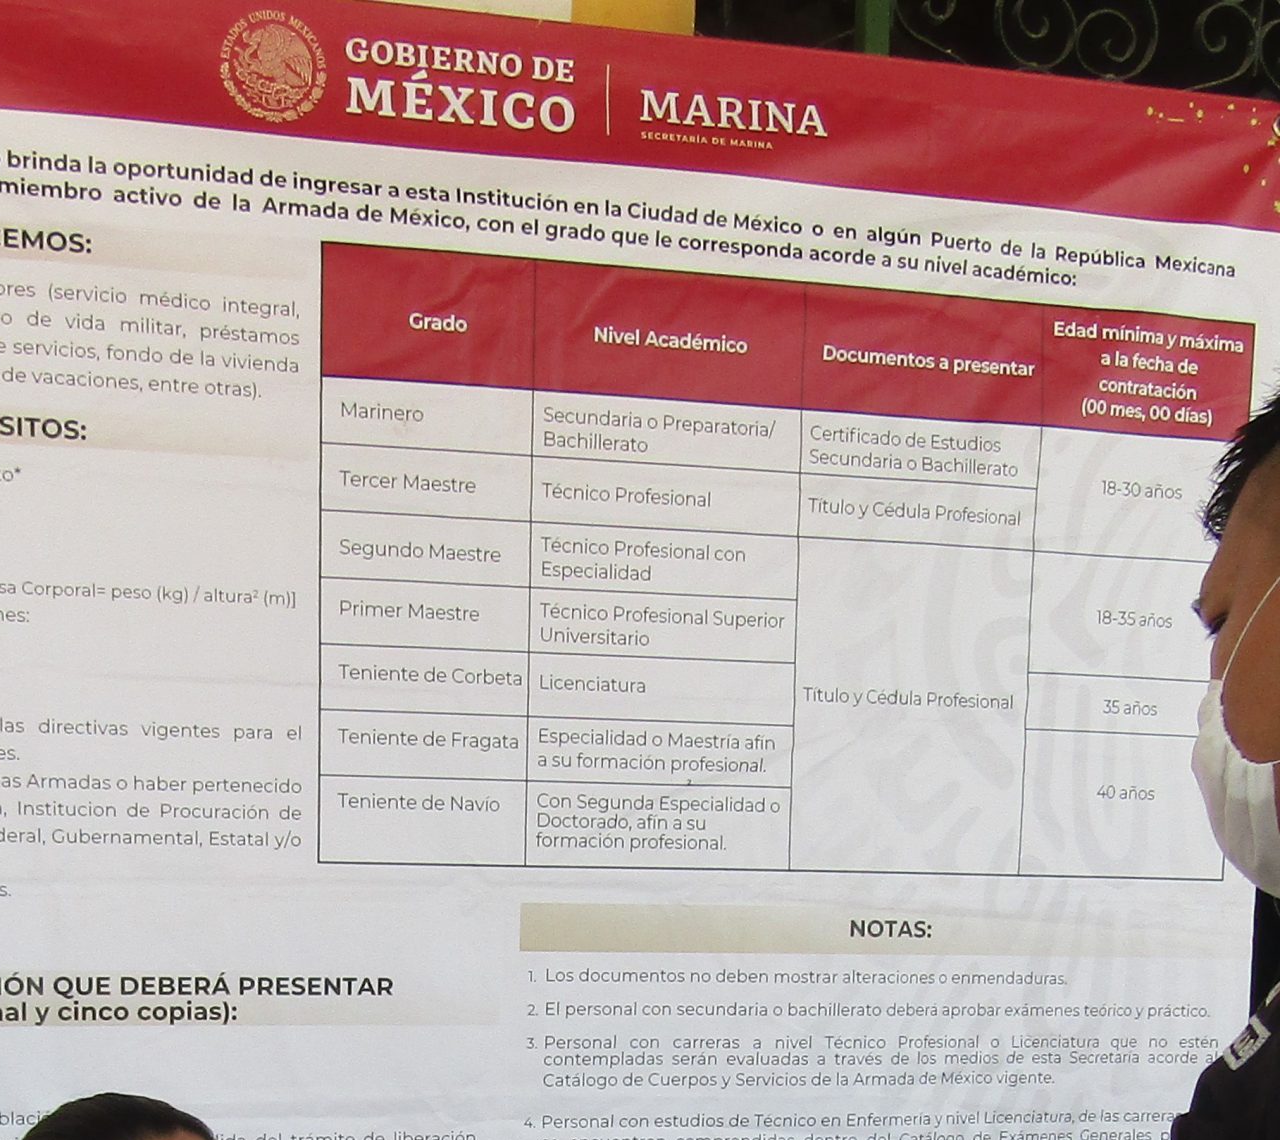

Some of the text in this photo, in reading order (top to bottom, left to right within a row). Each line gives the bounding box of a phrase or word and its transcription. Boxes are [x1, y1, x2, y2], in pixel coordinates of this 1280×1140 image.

[221, 10, 326, 69] ESTADOS UNIDOS MEXICANOS
[345, 37, 574, 83] GOBIERNO DE
[345, 69, 575, 133] MÉXICO
[640, 89, 828, 137] MARINA
[641, 131, 773, 150] SECRETARÍA DE MARINA
[7, 149, 81, 173] brinda
[88, 156, 106, 174] la
[113, 162, 253, 185] oportunidad
[259, 169, 287, 188] de
[293, 171, 382, 196] ingresar
[388, 185, 399, 198] a
[405, 186, 450, 202] esta
[456, 187, 568, 213] Institución
[573, 201, 599, 216] en
[605, 199, 622, 217] la
[627, 202, 698, 225] Ciudad
[703, 209, 728, 228] de
[733, 213, 802, 235] México
[812, 224, 824, 236] o
[833, 226, 857, 240] en
[867, 226, 921, 247] algún
[931, 232, 992, 253] Puerto
[1000, 239, 1022, 257] de
[1031, 242, 1046, 259] la
[1055, 246, 1145, 269] República
[1155, 255, 1235, 277] Mexicana
[113, 186, 182, 207] activo
[193, 190, 221, 210] de
[233, 193, 250, 212] la
[262, 196, 349, 220] Armada
[356, 204, 383, 223] de
[390, 207, 470, 233] México,
[477, 217, 514, 234] con
[521, 218, 539, 236] el
[545, 223, 605, 242] grado
[611, 230, 649, 248] que
[655, 229, 672, 248] le
[678, 237, 803, 259] corresponda
[809, 247, 876, 266] acorde
[881, 255, 892, 267] a
[897, 256, 919, 270] su
[924, 255, 968, 275] nivel
[972, 264, 1076, 286] académico:
[409, 312, 467, 332] Grado
[594, 326, 748, 353] Nivel Académico
[1054, 321, 1244, 353] Edad mínima y máxima
[823, 345, 1035, 376] Documentos a presentar
[1101, 350, 1198, 375] a la fecha de
[1099, 379, 1197, 400] contratación
[341, 401, 424, 422] Marinero
[1082, 397, 1212, 427] (00 mes, 00 días)
[339, 470, 476, 494] Tercer Maestre
[1101, 480, 1183, 500] 18-30 años
[541, 482, 711, 507] Técnico Profesional
[339, 539, 501, 563] Segundo Maestre
[340, 600, 480, 622] Primer Maestre
[1097, 610, 1172, 629] 18-35 años
[338, 664, 522, 686] Teniente de Corbeta
[540, 674, 646, 693] Licenciatura
[1102, 699, 1158, 716] 35 años
[337, 728, 519, 752] Teniente de Fragata
[337, 792, 500, 812] Teniente de Navío
[1096, 784, 1155, 801] 40 años
[850, 920, 932, 938] NOTAS:
[53, 976, 111, 1000] QUE
[120, 972, 231, 996] DEBERÁ
[239, 977, 393, 996] PRESENTAR
[528, 968, 1068, 985] 1. Los documentos no deben mostrar alteraciones o enmendaduras.
[34, 1006, 50, 1026] y
[58, 1000, 129, 1021] cinco
[137, 1000, 237, 1025] copias):
